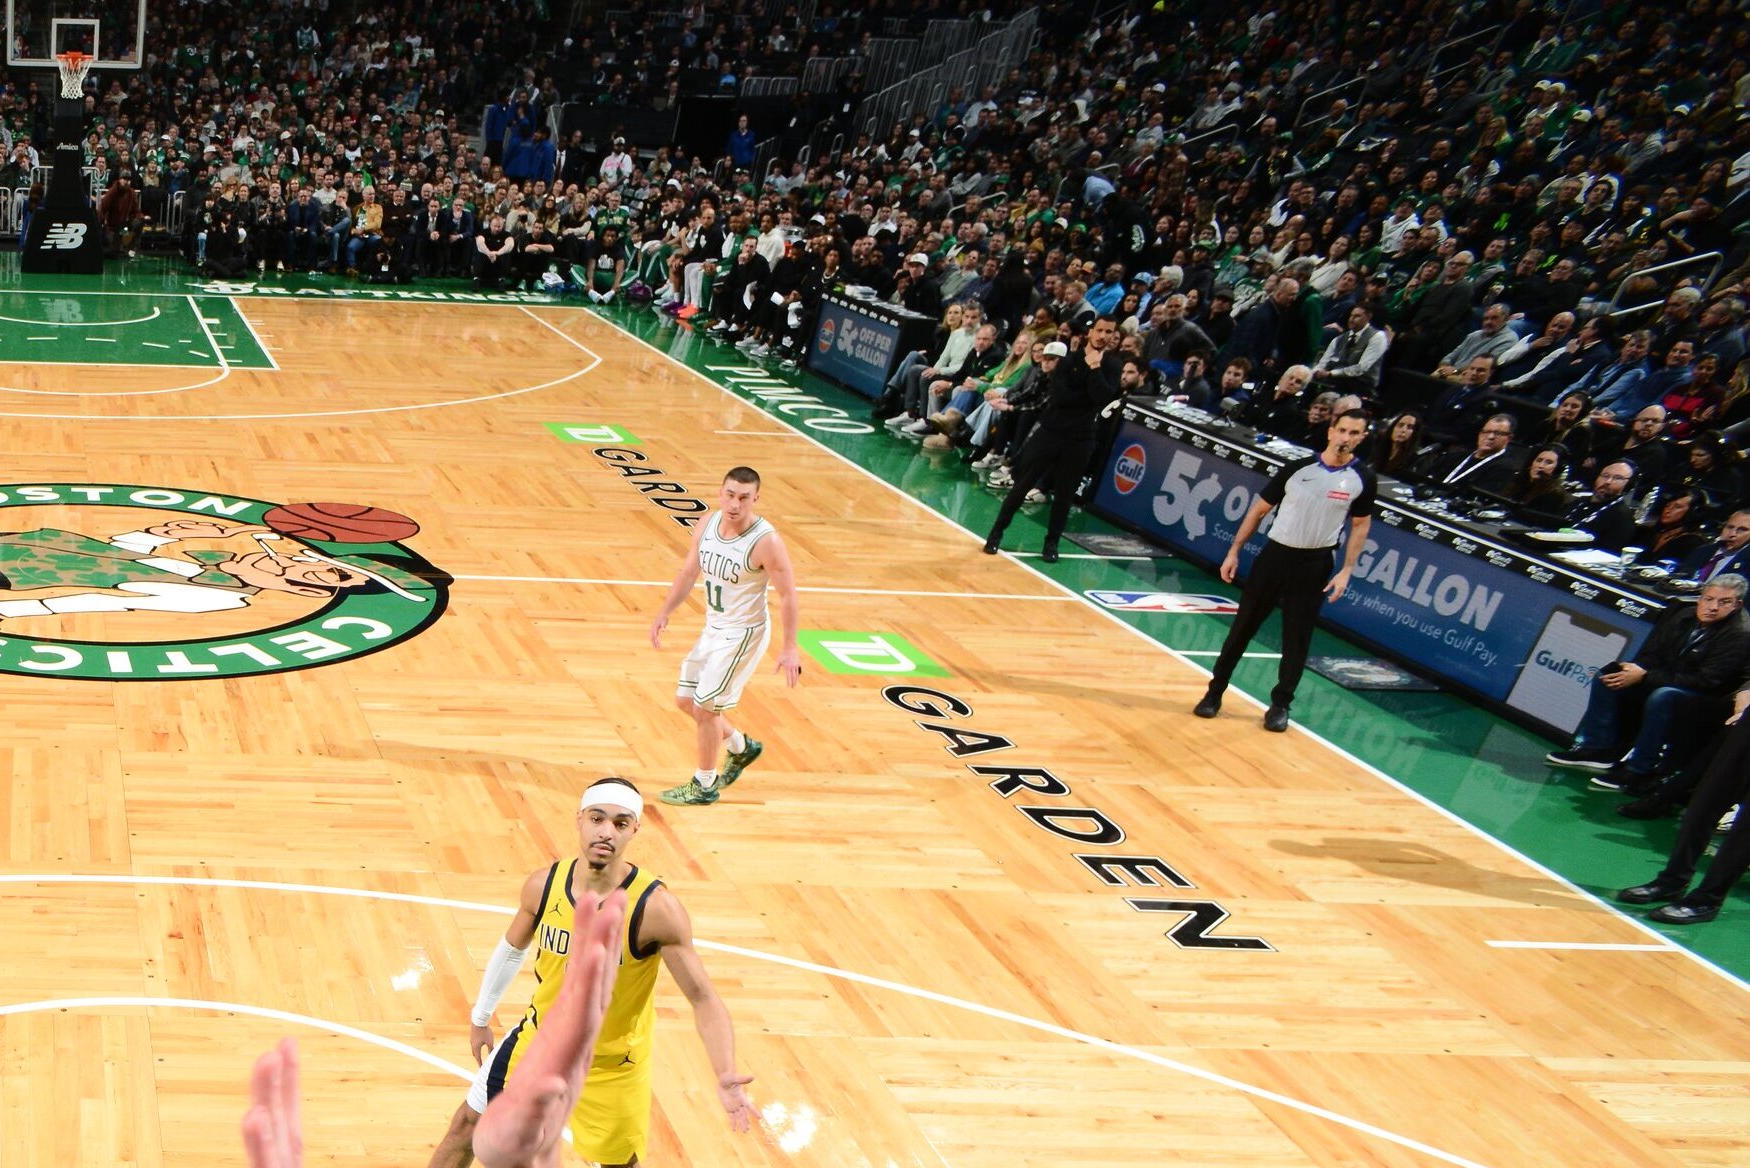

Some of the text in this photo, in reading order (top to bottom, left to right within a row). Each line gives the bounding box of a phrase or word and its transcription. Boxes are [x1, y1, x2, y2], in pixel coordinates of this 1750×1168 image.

[56, 142, 79, 150] Amica
[854, 343, 888, 369] GALLON
[858, 327, 877, 345] OFF
[874, 331, 892, 353] PER
[704, 364, 876, 435] PIMCO
[564, 425, 624, 443] TD
[1116, 457, 1144, 481] Gulf
[1152, 450, 1224, 542] 5¢
[699, 549, 741, 585] CELTICS
[704, 579, 725, 613] 11
[1351, 539, 1504, 632] GALLON
[1363, 595, 1395, 618] when
[1396, 608, 1418, 628] you
[1419, 620, 1442, 640] use
[1443, 628, 1473, 652] Gulf
[1472, 639, 1498, 668] Pay.
[818, 635, 917, 673] TD
[879, 683, 1280, 953] GARDEN
